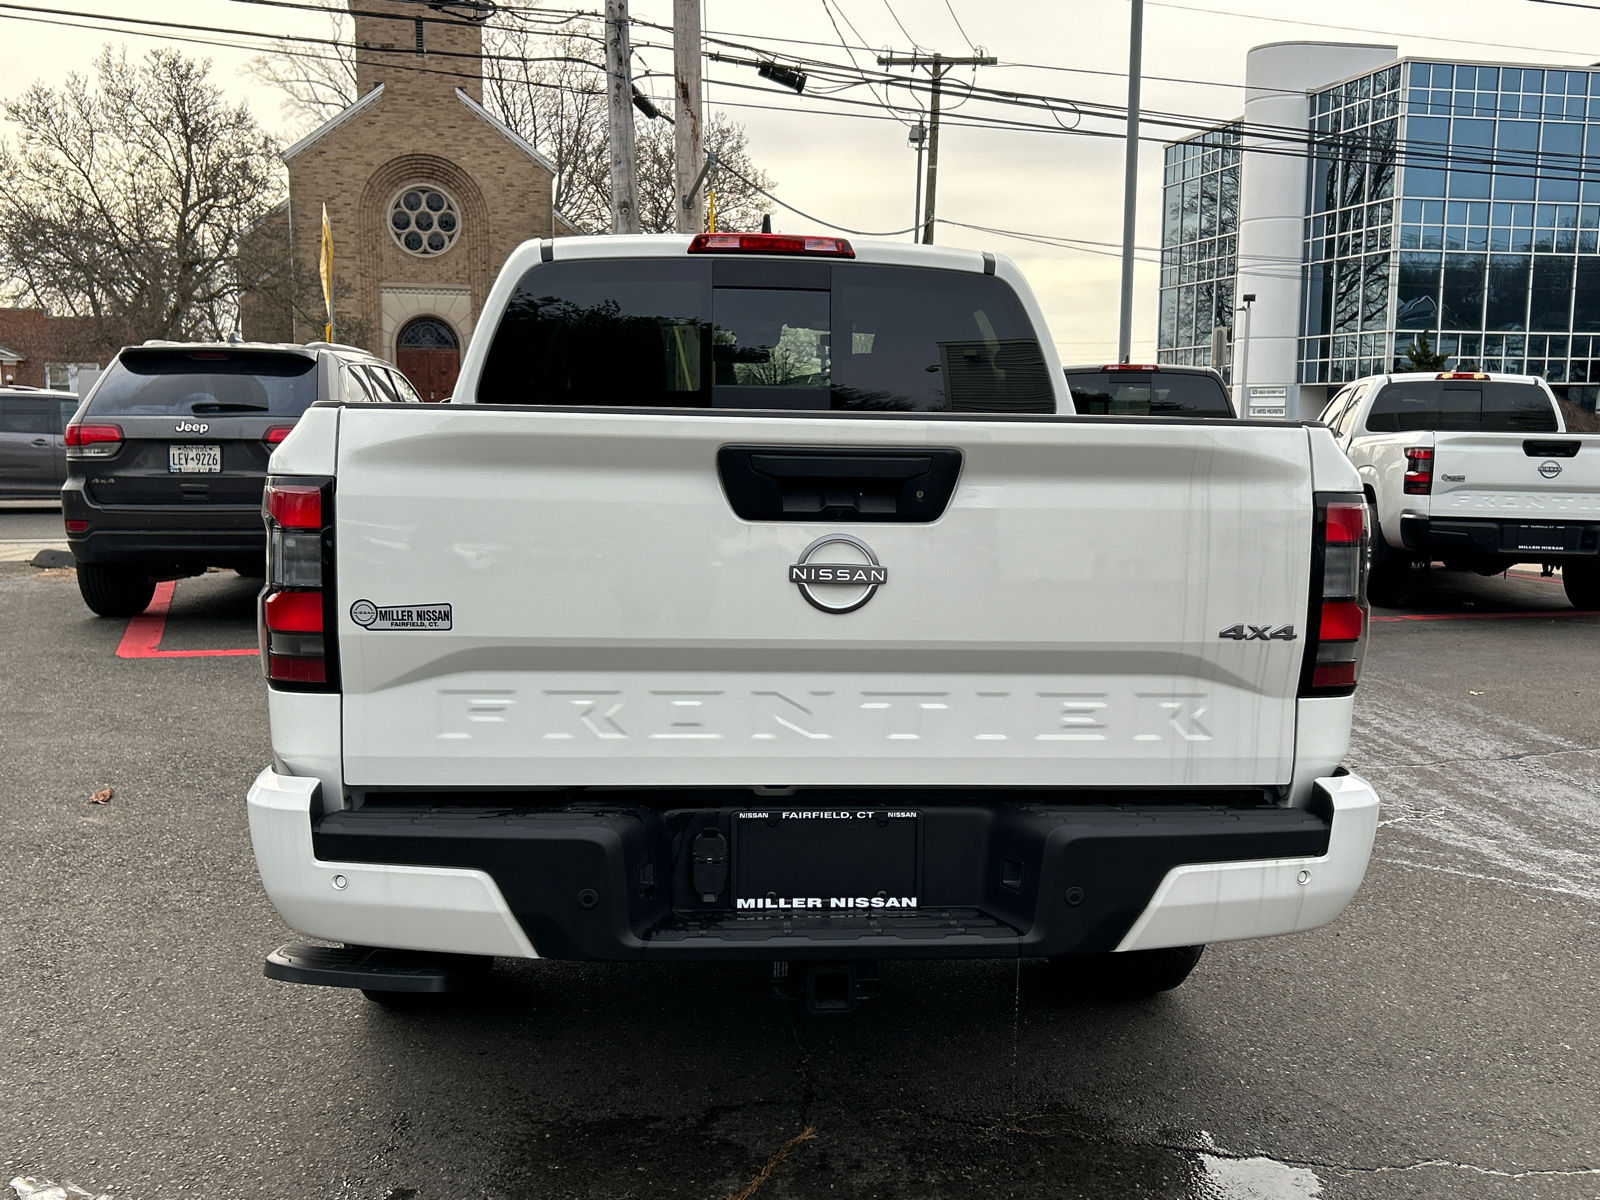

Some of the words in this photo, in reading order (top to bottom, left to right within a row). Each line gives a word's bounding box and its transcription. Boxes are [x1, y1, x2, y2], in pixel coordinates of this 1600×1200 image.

[175, 421, 209, 434] Jeep
[1451, 494, 1600, 510] FRONTI
[793, 568, 885, 581] NISSAN
[379, 610, 413, 621] MILLER
[416, 610, 449, 621] NISSAN
[436, 689, 1213, 741] FRONTIER
[782, 811, 853, 820] FAIRFIELD,
[856, 811, 875, 819] CT
[736, 898, 823, 908] MILLER
[830, 897, 917, 908] NISSAN
